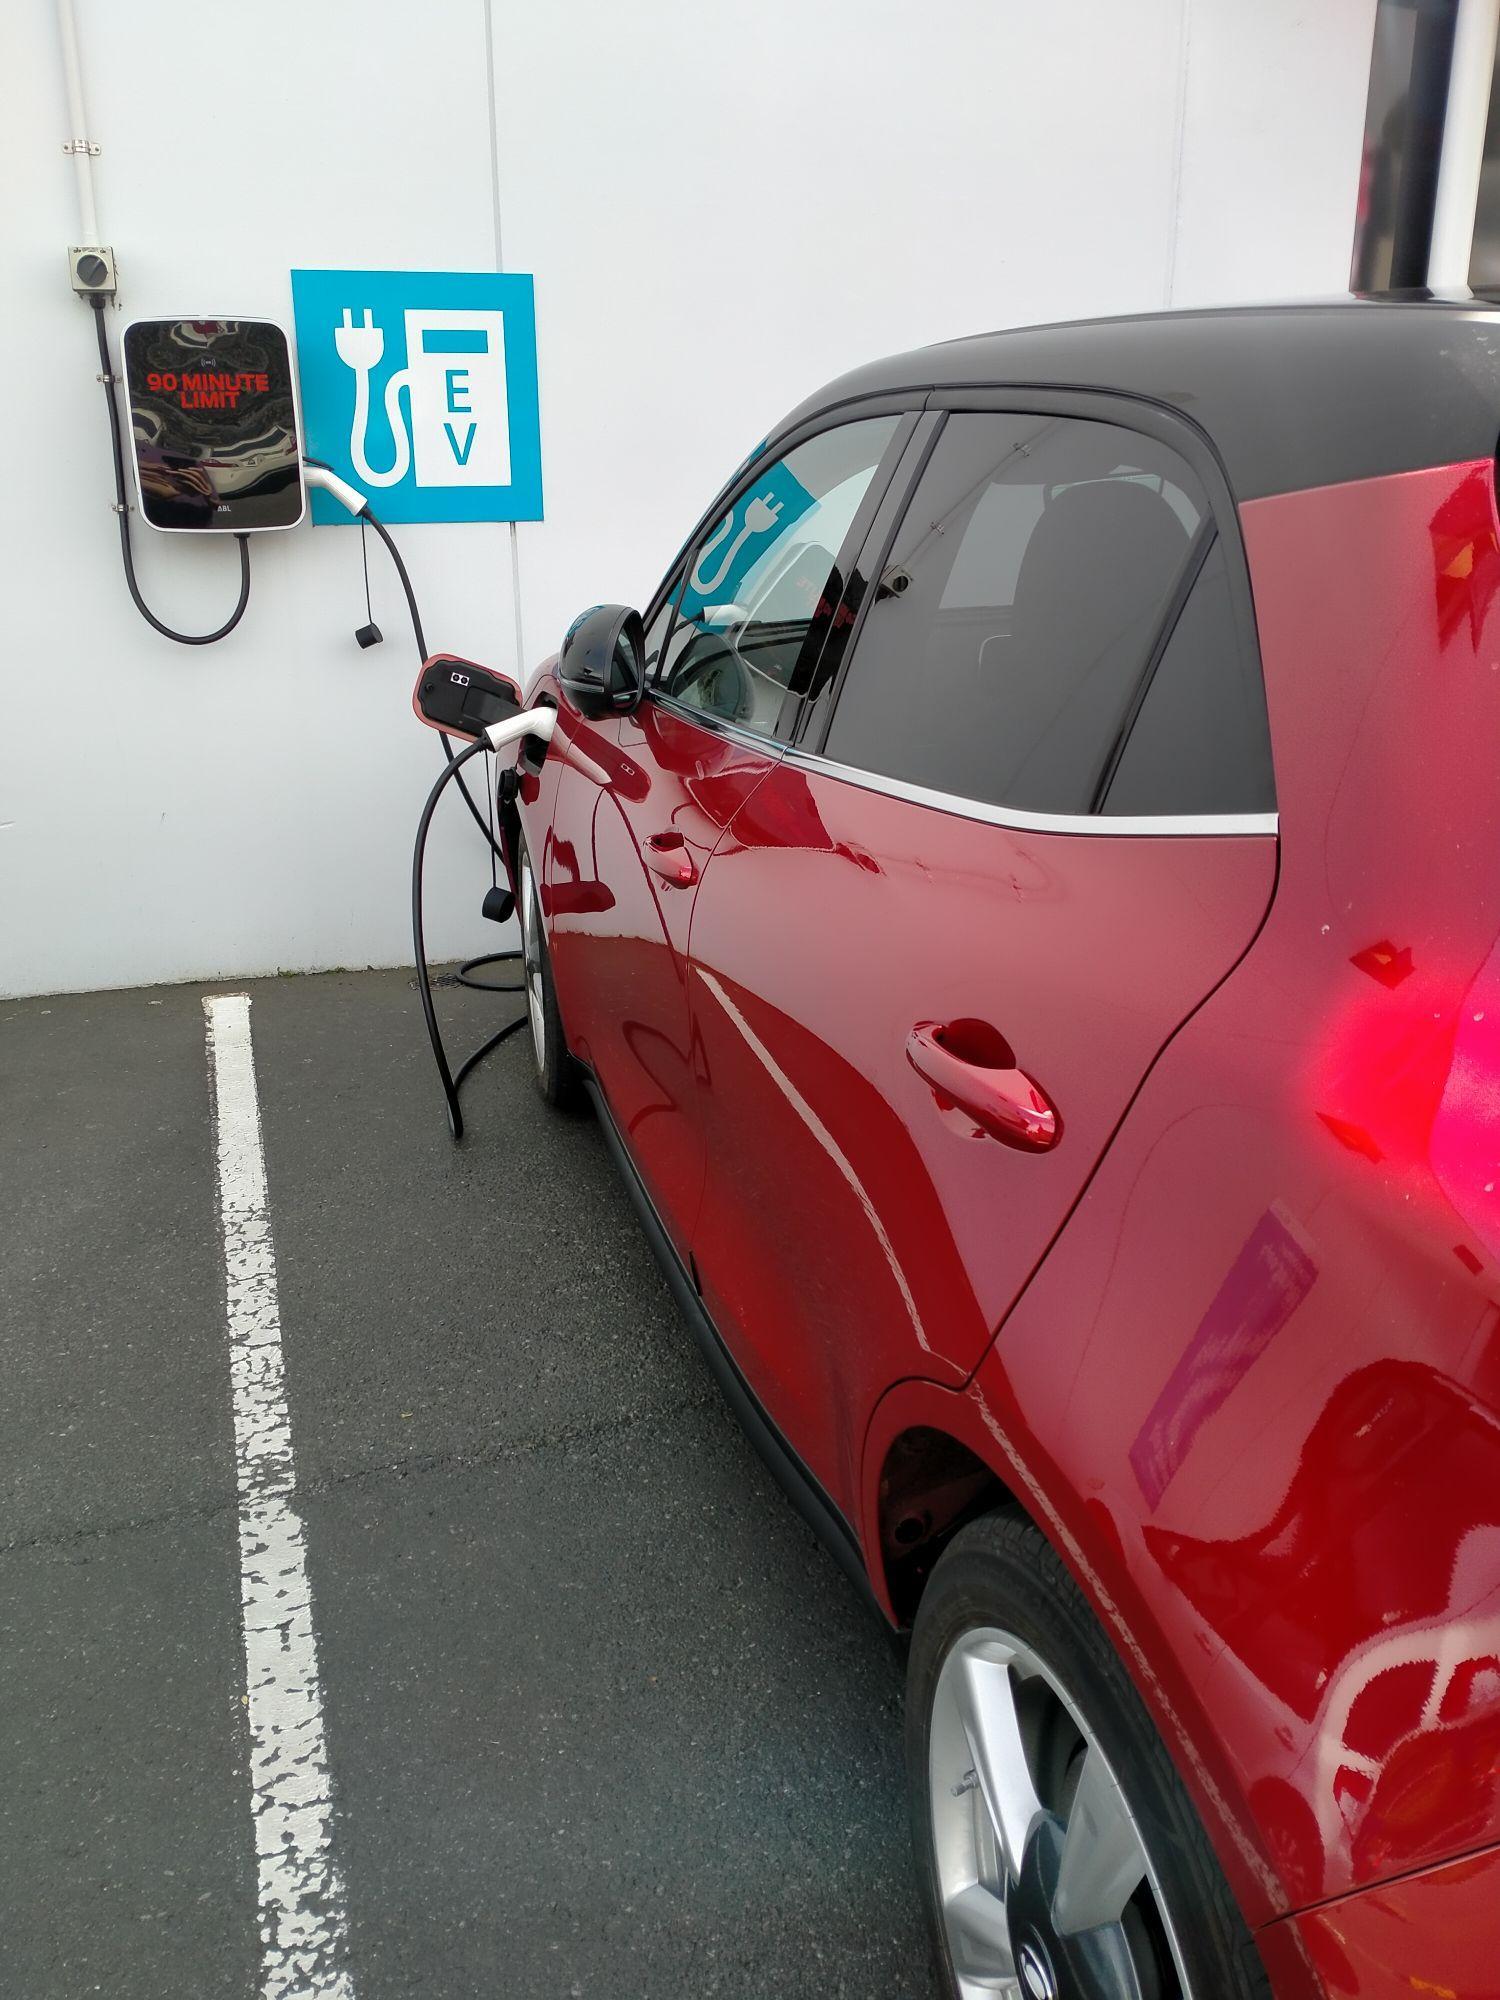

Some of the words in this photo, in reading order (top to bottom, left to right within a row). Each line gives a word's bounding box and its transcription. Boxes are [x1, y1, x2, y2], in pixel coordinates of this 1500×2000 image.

[147, 372, 177, 391] 90
[181, 372, 269, 392] MINUTE
[181, 391, 239, 409] LIMIT
